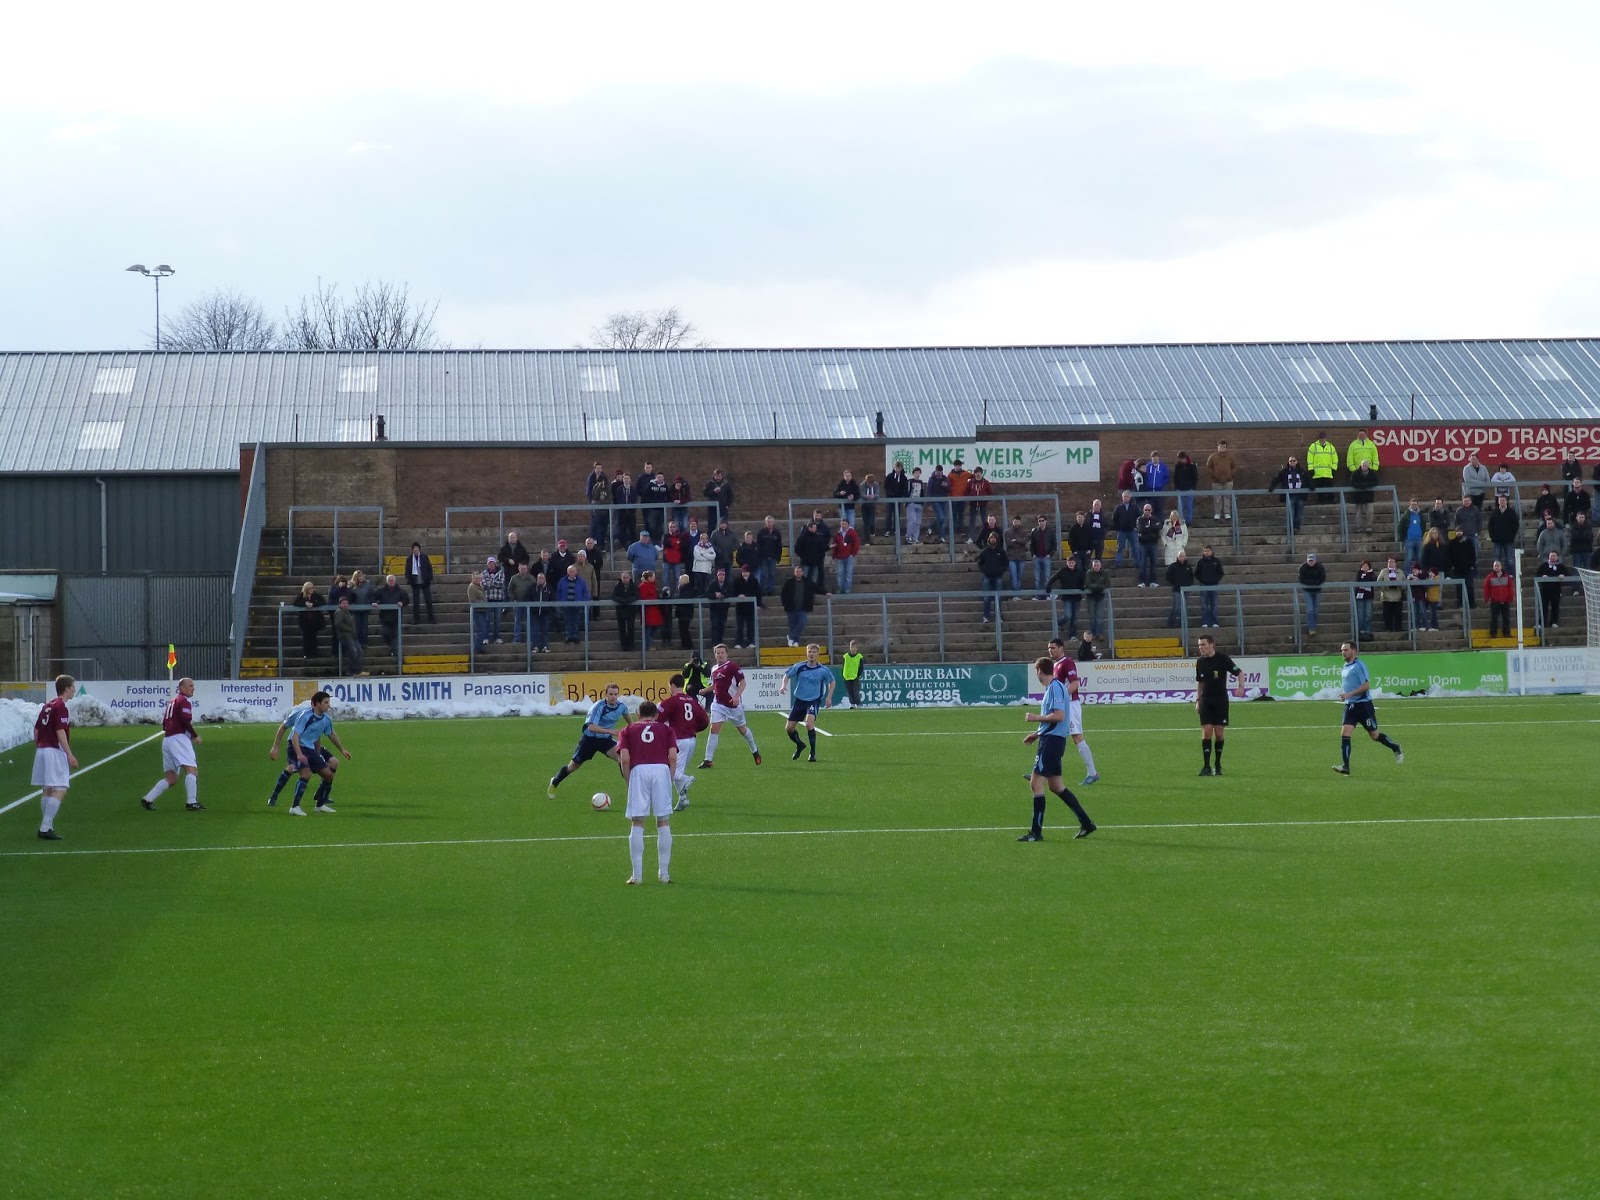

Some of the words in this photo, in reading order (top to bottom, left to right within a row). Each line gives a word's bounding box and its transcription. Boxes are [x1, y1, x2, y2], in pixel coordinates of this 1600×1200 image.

[1373, 429, 1439, 446] SANDY
[1446, 428, 1502, 445] KYDD
[919, 448, 965, 466] MIKE
[975, 448, 1024, 465] WEIR
[1030, 445, 1058, 466] Your
[1066, 447, 1094, 465] MP
[1403, 447, 1480, 462] 01307
[1505, 446, 1600, 461] 462122
[990, 469, 1033, 479] 463475
[1532, 655, 1583, 665] JOHNSTON
[860, 668, 932, 681] EXANDER
[934, 667, 972, 680] BAIN
[1276, 666, 1308, 676] ASDA
[1312, 665, 1342, 676] Forfa
[1533, 664, 1587, 672] CARMICHA
[1096, 676, 1129, 684] Couriers
[1132, 675, 1165, 684] Haulage
[1169, 674, 1196, 684] Storag
[1374, 676, 1418, 687] 7.30am
[1428, 675, 1461, 687] 10pm
[1480, 674, 1504, 682] ASDA
[126, 684, 171, 697] Fostering
[221, 682, 272, 693] Interested
[274, 682, 284, 692] in
[905, 681, 957, 689] DIRECTORS
[1276, 678, 1309, 691] Open
[379, 683, 396, 702] M.
[401, 682, 452, 701] SMITH
[464, 681, 546, 696] Panasonic
[859, 689, 902, 702] 01307
[906, 688, 961, 701] 463285
[110, 698, 156, 709] Adoption
[684, 702, 693, 721] 8
[641, 725, 655, 743] 6
